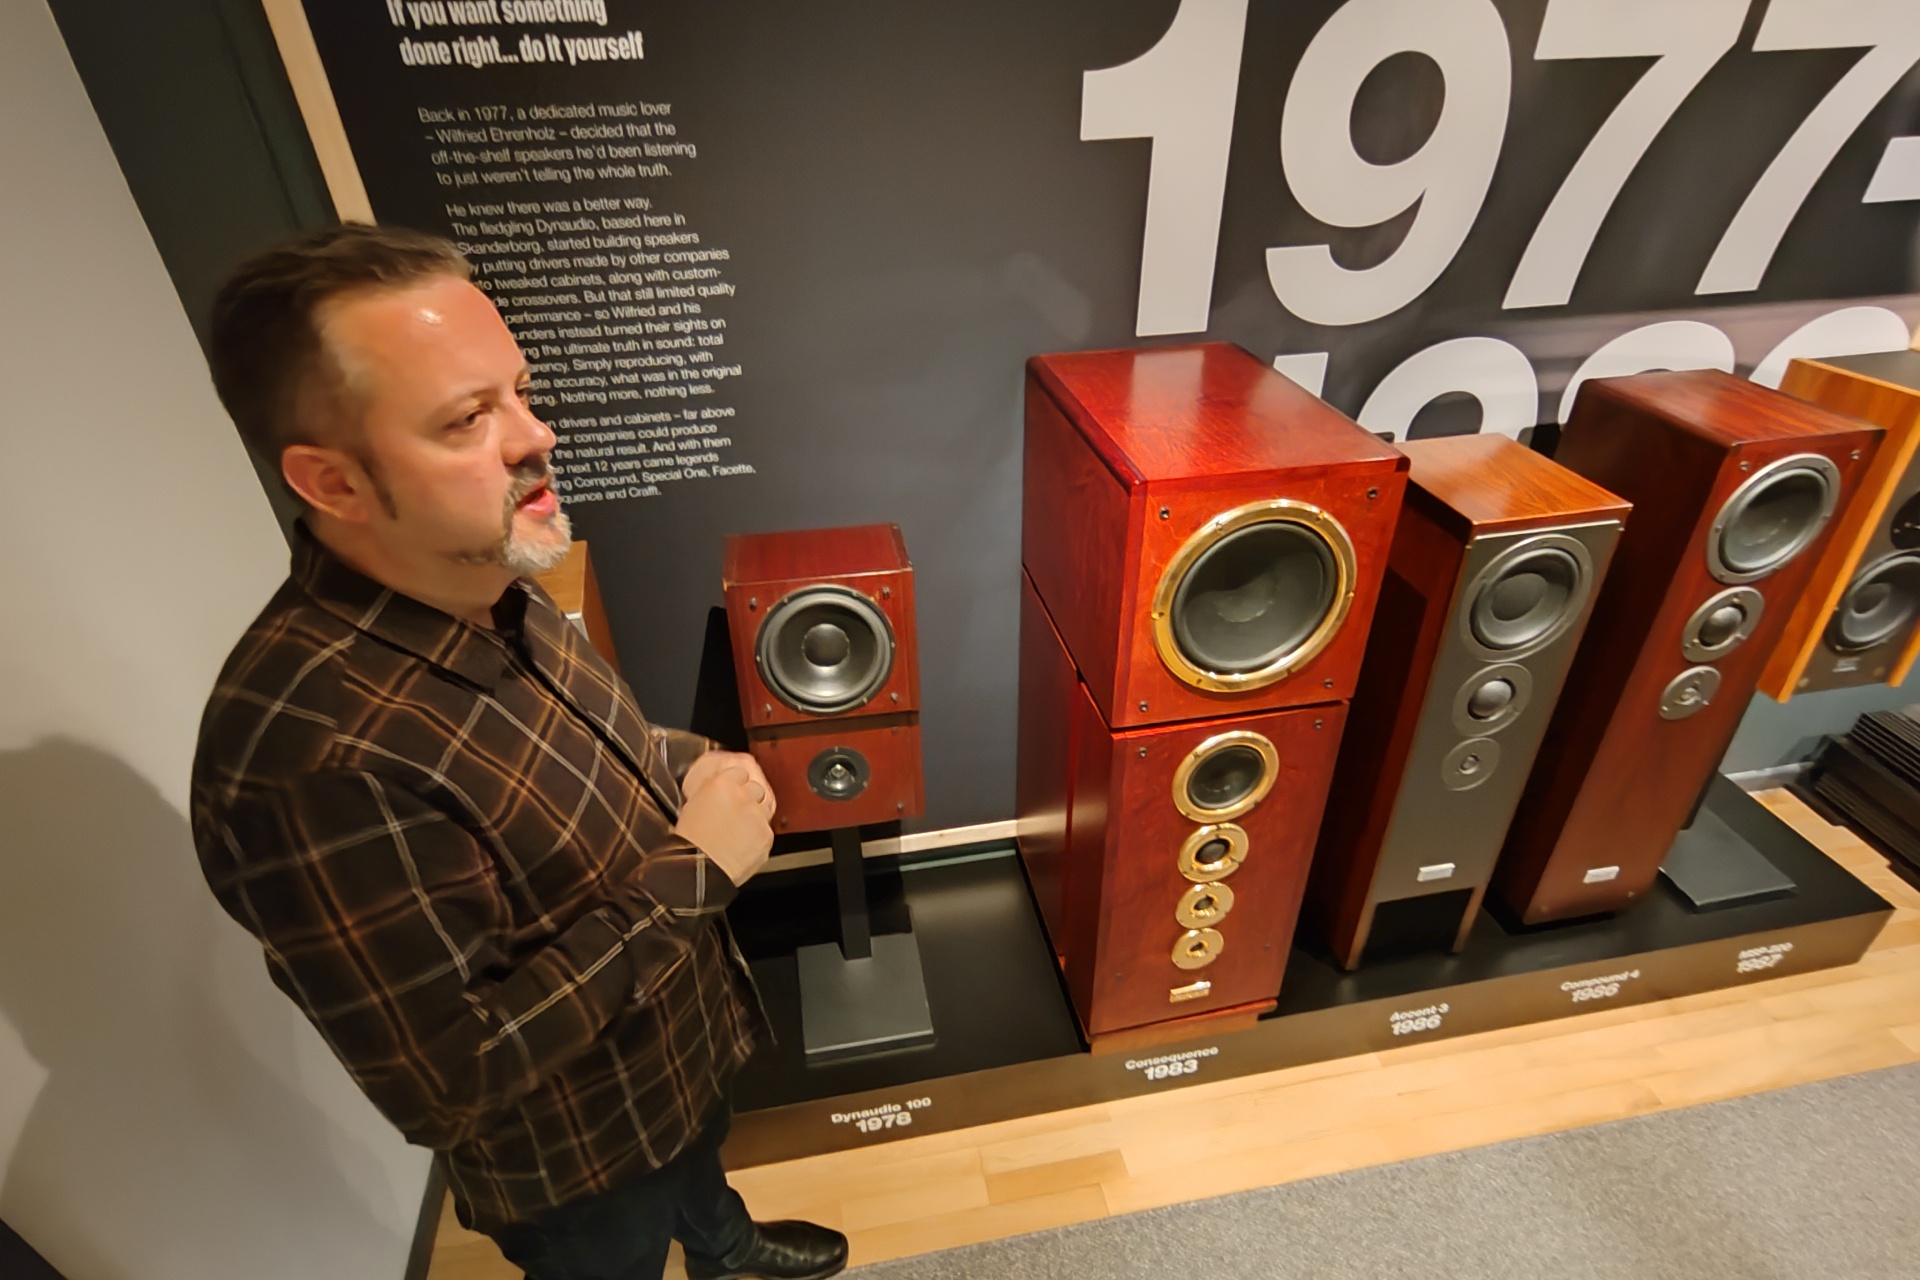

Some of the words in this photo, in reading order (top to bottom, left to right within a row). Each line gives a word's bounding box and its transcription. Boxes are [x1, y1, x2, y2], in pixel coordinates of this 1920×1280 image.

[385, 0, 407, 26] If
[406, 1, 448, 30] you
[446, 0, 502, 25] want
[500, 0, 607, 26] something
[399, 36, 452, 66] done
[518, 33, 546, 62] do
[545, 33, 564, 62] it
[563, 30, 644, 66] yourself
[417, 105, 456, 122] Back
[457, 107, 472, 121] in
[517, 107, 527, 120] a
[528, 103, 595, 119] dedicated
[598, 102, 637, 117] music
[640, 101, 671, 116] lover
[435, 128, 488, 143] Wilfried
[570, 123, 624, 139] decided
[626, 122, 652, 138] that
[654, 121, 676, 136] the
[431, 147, 511, 165] off-the-shelf
[514, 146, 574, 164] speakers
[575, 144, 606, 160] he'd
[607, 143, 642, 159] been
[644, 141, 697, 158] listening
[436, 171, 452, 185] to
[453, 170, 479, 189] just
[480, 167, 531, 184] weren't
[532, 166, 572, 184] telling
[573, 165, 595, 180] the
[596, 164, 636, 179] whole
[638, 162, 672, 178] truth.
[445, 203, 467, 217] He
[467, 202, 504, 217] knew
[506, 201, 541, 215] there
[542, 200, 571, 213] was
[572, 200, 582, 212] a
[583, 197, 621, 212] better
[623, 197, 653, 211] way.
[451, 222, 478, 237] The
[535, 218, 600, 235] Dynaudio,
[601, 215, 641, 231] based
[642, 213, 672, 228] here
[673, 212, 686, 226] in
[546, 236, 590, 252] started
[592, 234, 642, 250] building
[643, 232, 700, 248] speakers
[482, 260, 527, 275] putting
[528, 257, 571, 271] drivers
[572, 255, 609, 270] made
[610, 252, 627, 268] by
[628, 251, 661, 266] other
[663, 248, 730, 264] companies
[494, 275, 548, 291] tweaked
[549, 272, 607, 288] cabinets,
[608, 271, 643, 286] along
[644, 268, 671, 283] with
[672, 267, 722, 281] custom-
[511, 293, 581, 308] crossovers.
[582, 290, 606, 304] But
[607, 288, 632, 302] that
[634, 287, 655, 301] still
[655, 284, 695, 299] limited
[697, 283, 736, 298] quality
[504, 310, 582, 326] performance
[594, 309, 610, 320] so
[610, 304, 656, 319] Wilfried
[658, 303, 681, 316] and
[682, 302, 702, 314] his
[557, 325, 602, 338] instead
[603, 322, 642, 336] turned
[644, 320, 670, 334] their
[672, 319, 708, 334] sights
[710, 319, 727, 330] on
[541, 344, 561, 356] the
[563, 341, 611, 355] ultimate
[612, 338, 640, 352] truth
[642, 338, 653, 350] in
[697, 333, 724, 346] total
[572, 357, 612, 372] Simply
[613, 354, 687, 370] reproducing,
[689, 350, 714, 363] with
[553, 377, 608, 388] accuracy,
[610, 371, 640, 385] what
[641, 372, 666, 383] was
[667, 370, 679, 381] in
[680, 368, 700, 380] the
[701, 363, 743, 380] original
[560, 391, 607, 405] Nothing
[608, 388, 642, 400] more,
[644, 384, 687, 398] nothing
[687, 382, 715, 395] less.
[558, 415, 597, 429] drivers
[599, 414, 621, 427] and
[623, 411, 672, 425] cabinets
[682, 407, 698, 420] far
[700, 406, 735, 419] above
[573, 430, 635, 444] companies
[637, 426, 670, 439] could
[671, 423, 718, 438] produce
[554, 448, 574, 460] the
[575, 445, 615, 458] natural
[616, 443, 650, 456] result.
[652, 440, 676, 452] And
[677, 438, 701, 450] with
[702, 436, 732, 448] them
[566, 462, 592, 474] next
[593, 460, 609, 472] 12
[610, 458, 642, 473] years
[643, 456, 675, 468] came
[675, 452, 720, 467] legends
[641, 469, 682, 484] Special
[605, 488, 627, 500] and
[1143, 1058, 1198, 1081] 1983
[830, 1103, 902, 1125] Dynaudio
[904, 1096, 932, 1111] 100
[855, 1111, 912, 1134] 1978
